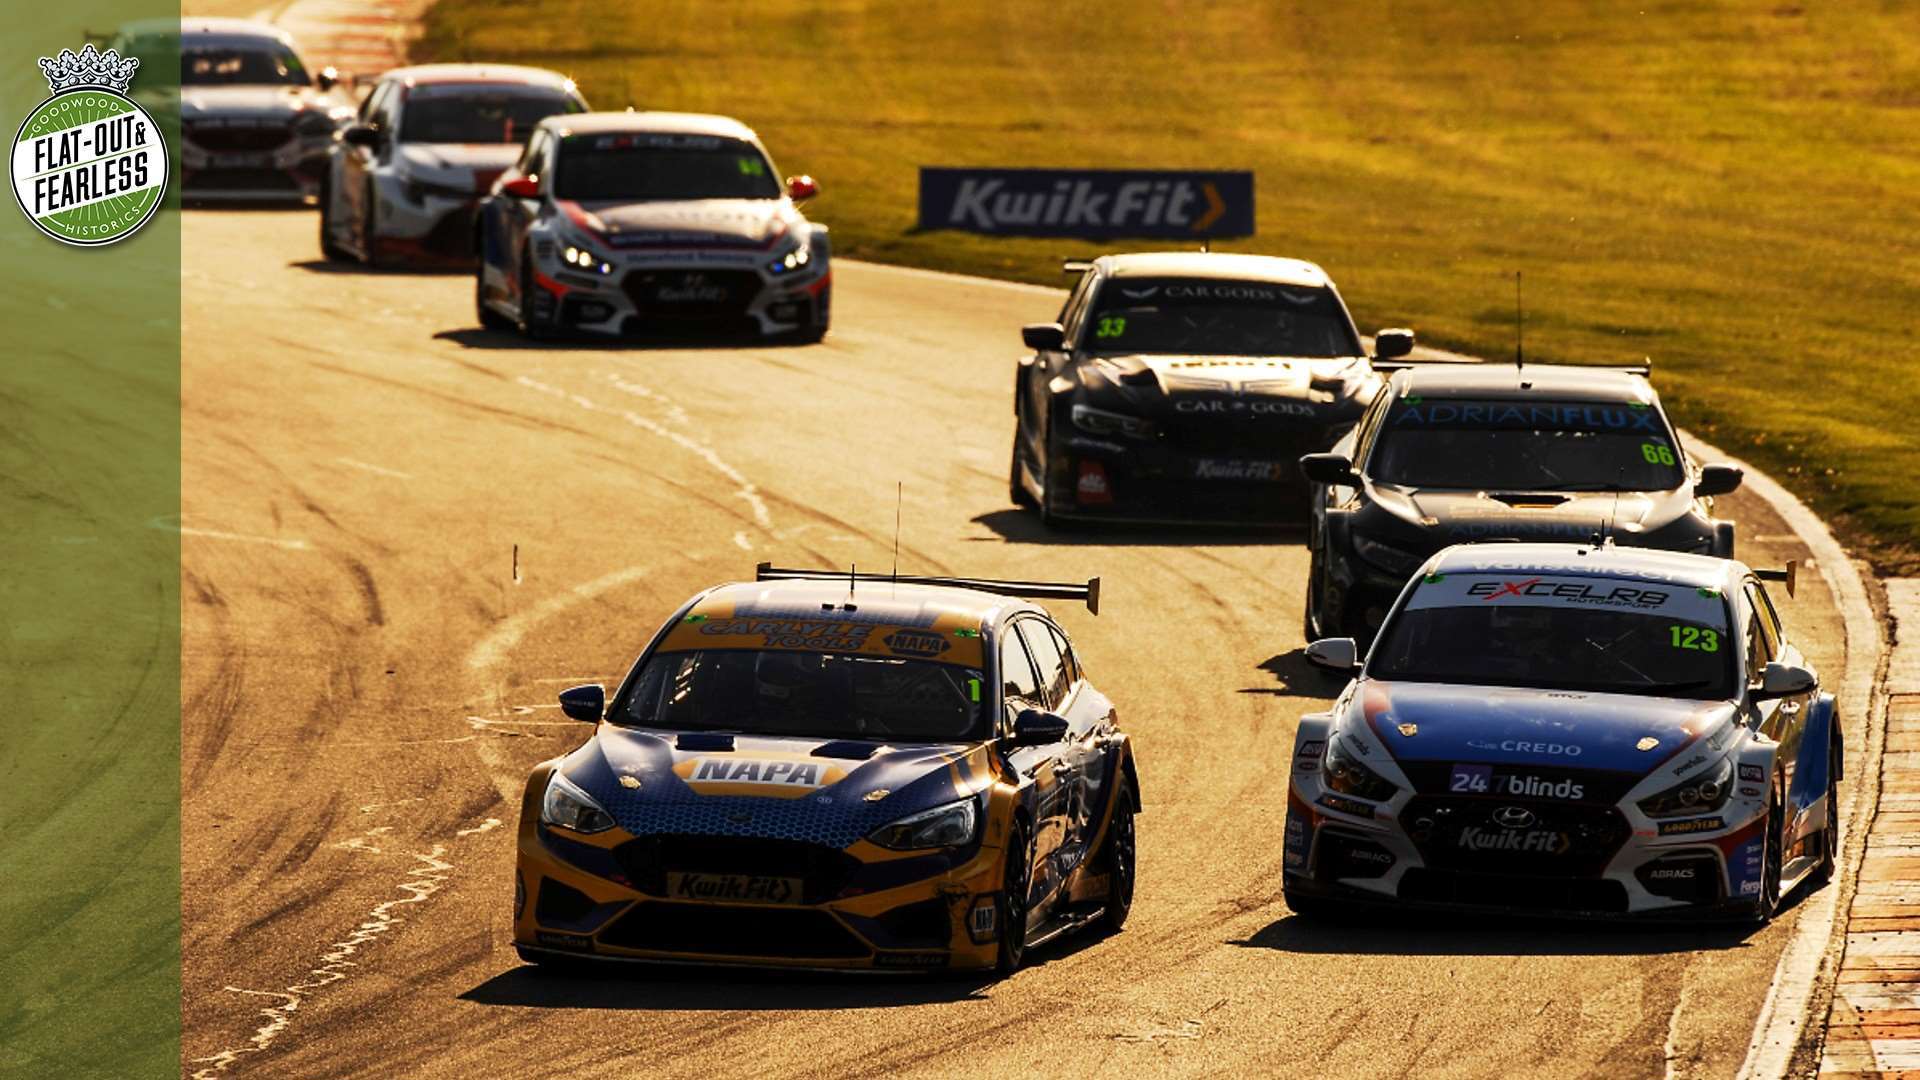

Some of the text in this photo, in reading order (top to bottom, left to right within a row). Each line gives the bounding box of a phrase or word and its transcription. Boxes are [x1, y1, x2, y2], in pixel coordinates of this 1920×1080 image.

[1165, 287, 1276, 300] CAR GODS
[1096, 317, 1127, 338] 33
[1175, 400, 1315, 416] CAR GODS
[1641, 443, 1676, 467] 66
[1566, 597, 1661, 609] MOTORSPORT
[700, 621, 874, 637] CARLYLE
[764, 635, 867, 651] TOOLS
[893, 636, 944, 651] NAPA
[1669, 624, 1720, 653] 123
[968, 677, 983, 704] 1
[1501, 740, 1582, 756] CREDO
[696, 759, 818, 785] NAPA
[1508, 775, 1585, 800] blinds
[1651, 868, 1696, 879] ABRACS
